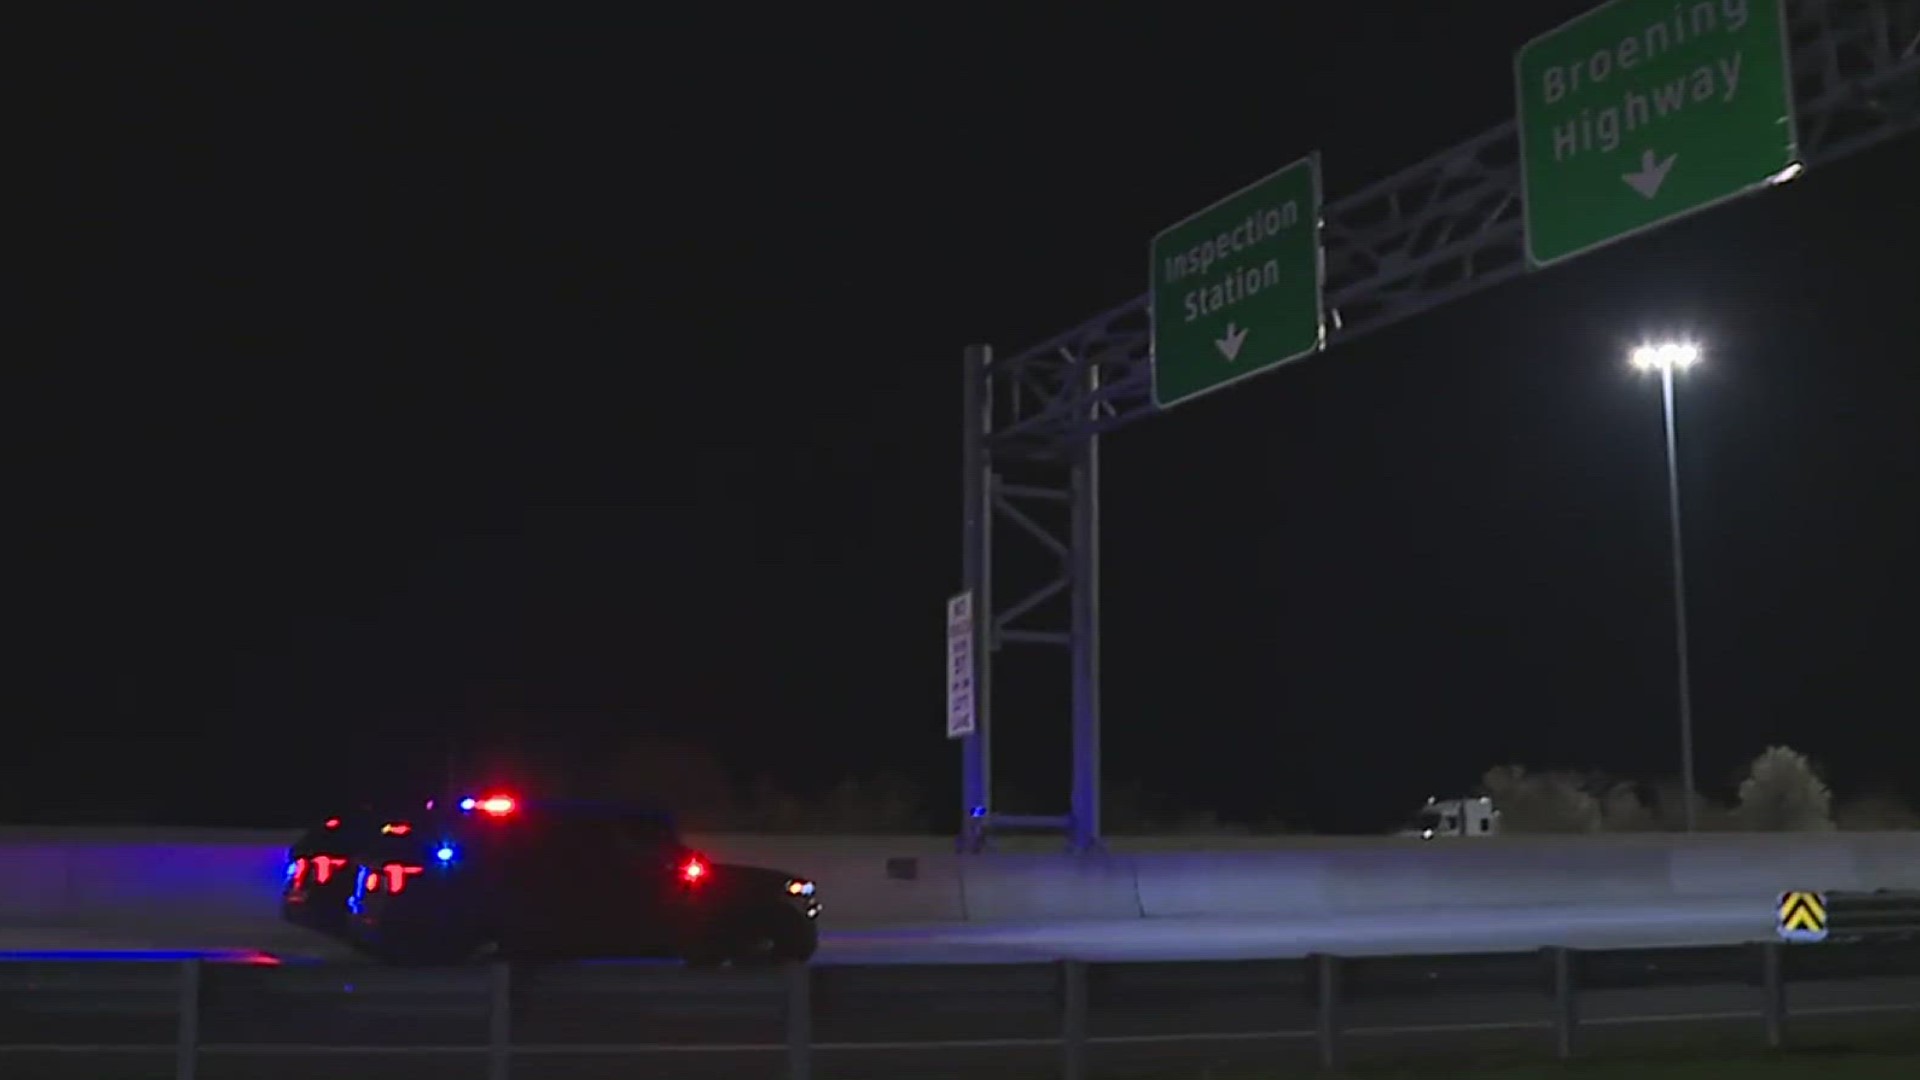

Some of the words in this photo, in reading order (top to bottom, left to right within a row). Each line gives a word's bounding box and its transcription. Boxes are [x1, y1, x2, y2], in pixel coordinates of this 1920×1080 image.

[1544, 0, 1748, 103] Broening
[1554, 51, 1741, 160] Highway
[1165, 200, 1297, 283] Inspection
[1185, 259, 1279, 322] Station
